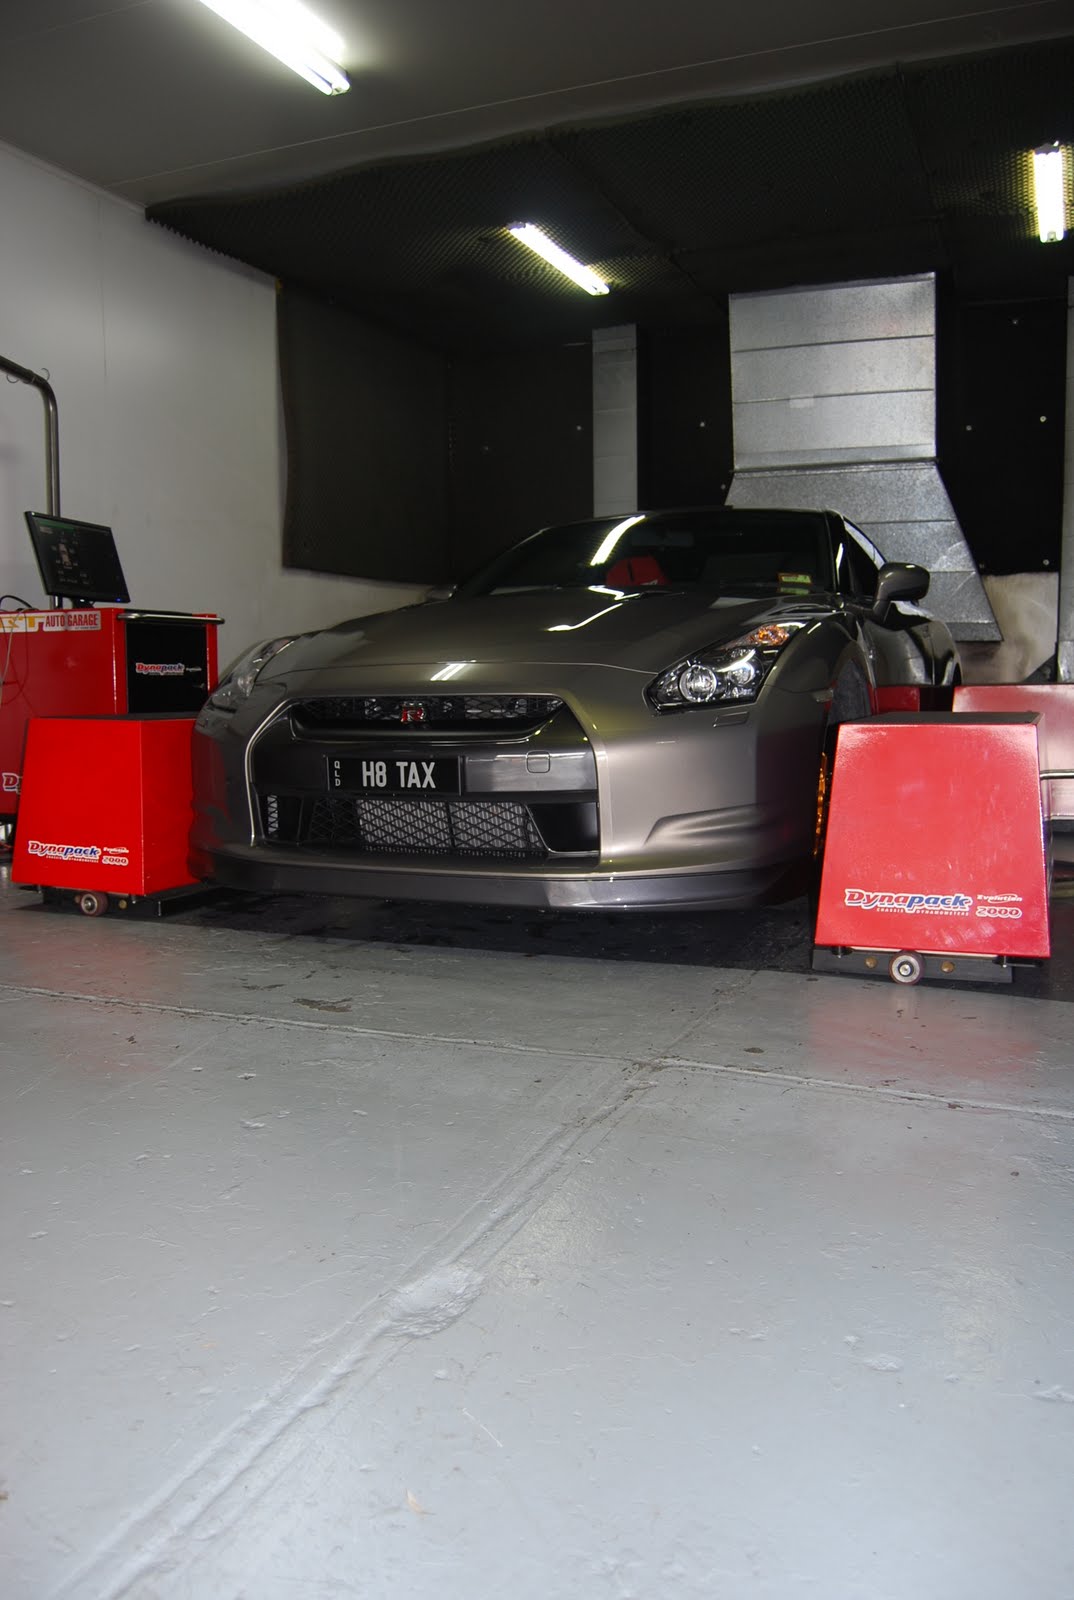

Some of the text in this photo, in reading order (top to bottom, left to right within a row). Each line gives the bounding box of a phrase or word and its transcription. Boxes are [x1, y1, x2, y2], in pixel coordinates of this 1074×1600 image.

[45, 615, 65, 628] AUTO
[67, 613, 98, 627] GARAGE
[136, 662, 185, 676] Dynapack
[362, 761, 436, 788] H8 TAX
[28, 840, 101, 861] Dynapack
[102, 855, 129, 867] 2000
[845, 889, 973, 914] Dynapack
[976, 893, 1023, 904] Evolution
[976, 906, 1023, 918] 2000
